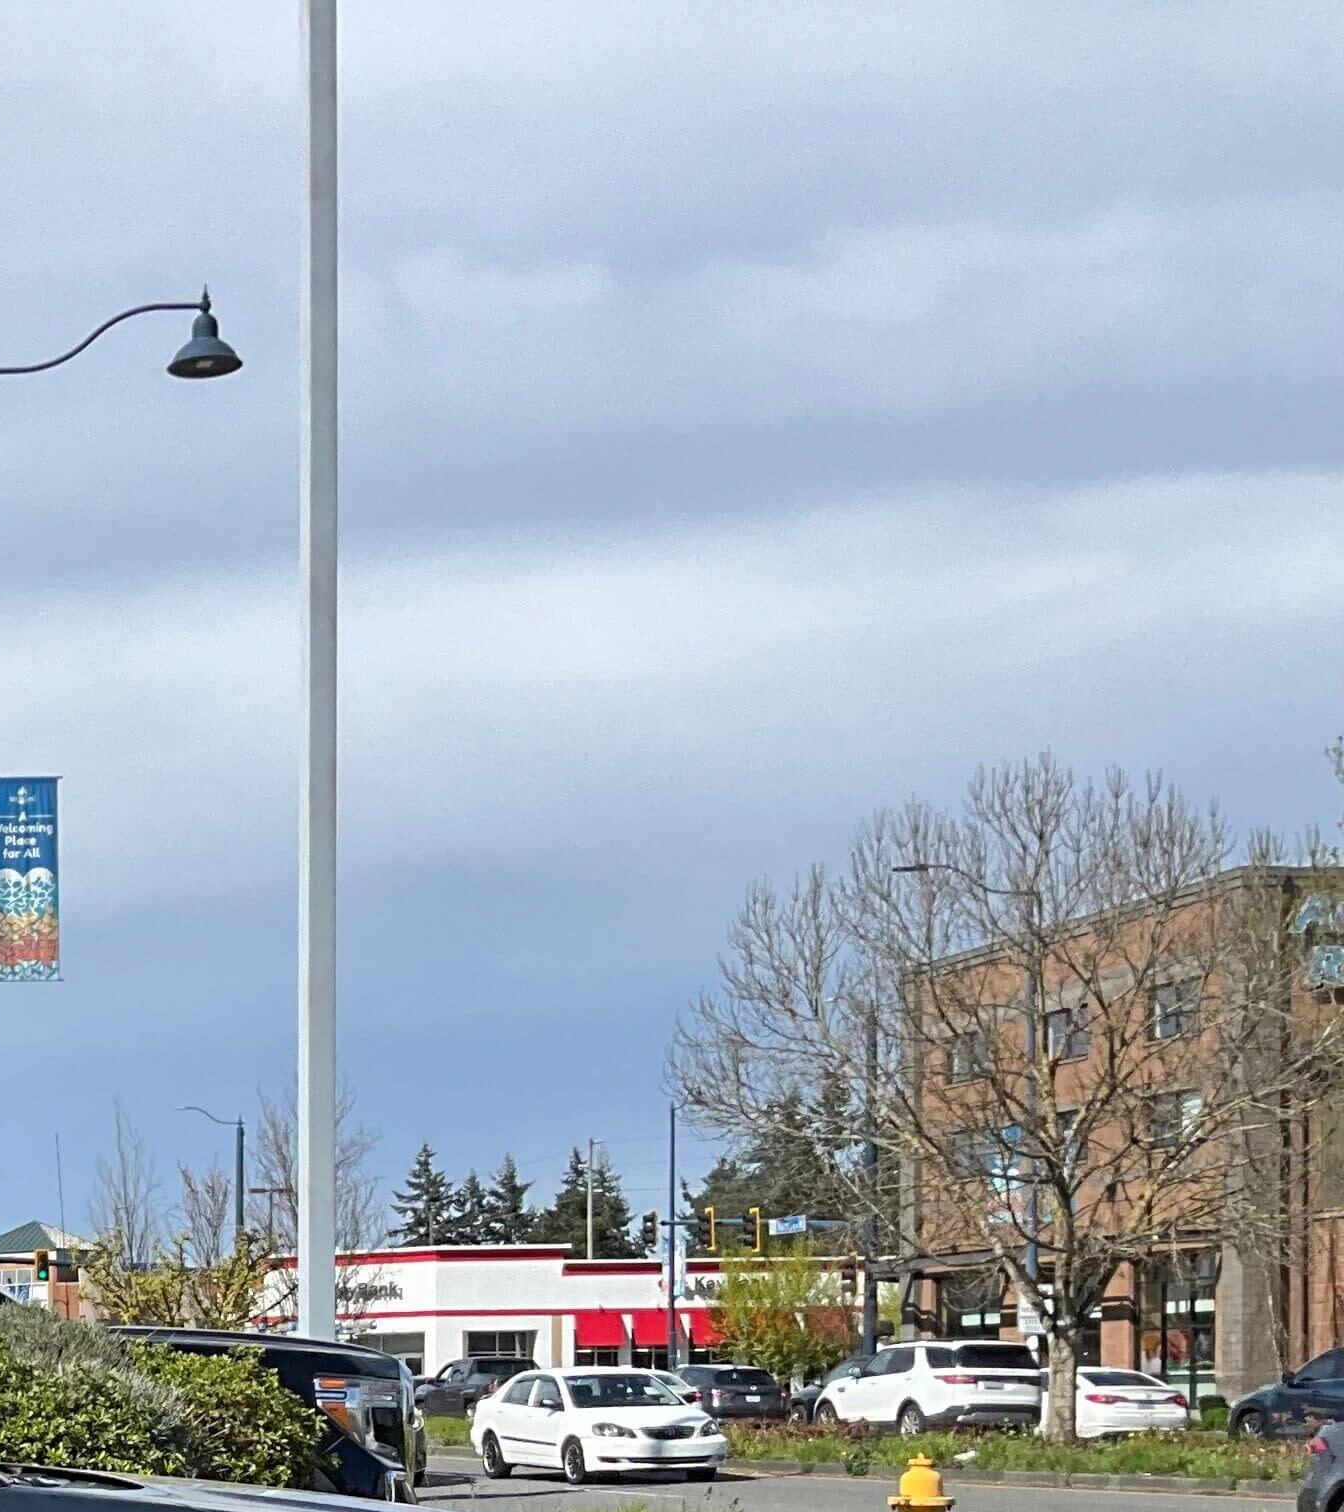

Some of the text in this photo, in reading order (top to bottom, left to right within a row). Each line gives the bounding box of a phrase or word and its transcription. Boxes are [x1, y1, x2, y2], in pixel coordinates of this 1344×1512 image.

[18, 811, 27, 822] A
[5, 835, 37, 846] Place
[2, 847, 41, 859] for All
